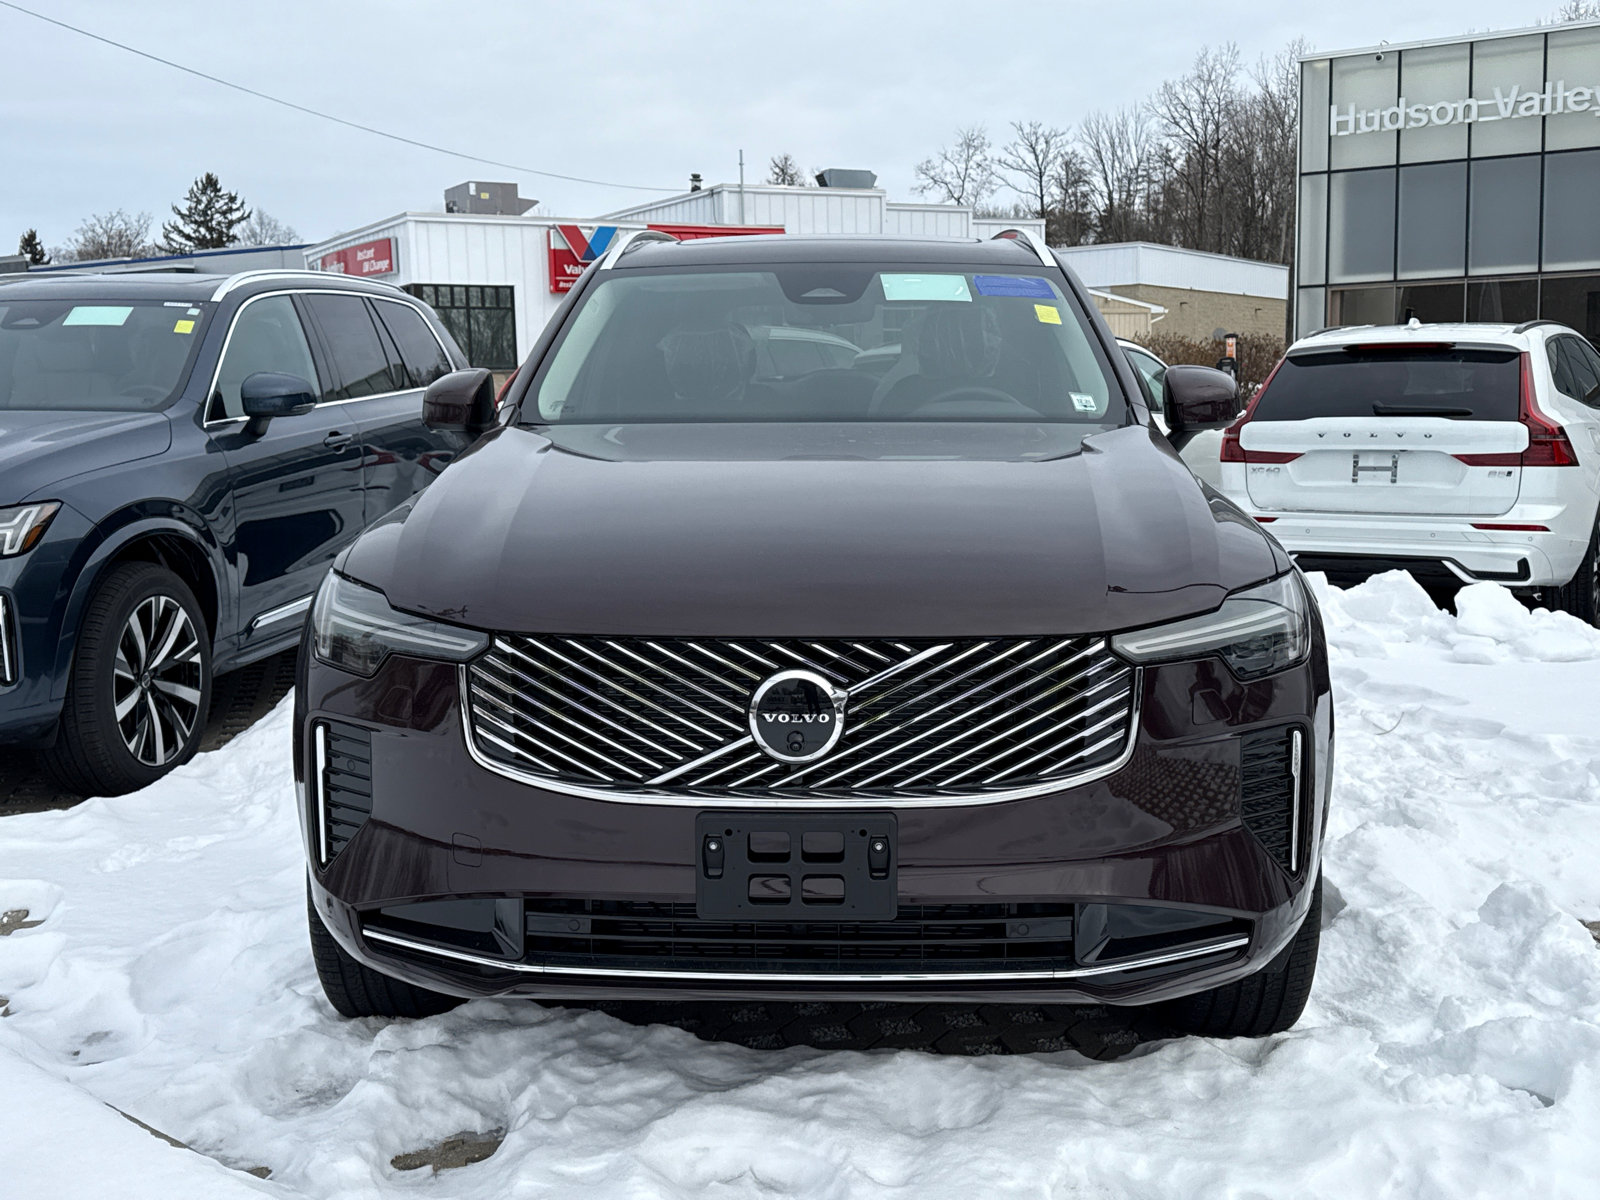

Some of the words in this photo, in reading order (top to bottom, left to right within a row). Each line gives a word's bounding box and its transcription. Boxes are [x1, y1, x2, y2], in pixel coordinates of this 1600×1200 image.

[1330, 97, 1479, 136] Hudson
[1492, 80, 1600, 118] Valle
[356, 247, 375, 261] Instant
[369, 259, 390, 272] Change
[1316, 431, 1434, 439] VOLVO
[762, 713, 830, 723] VOLVO
